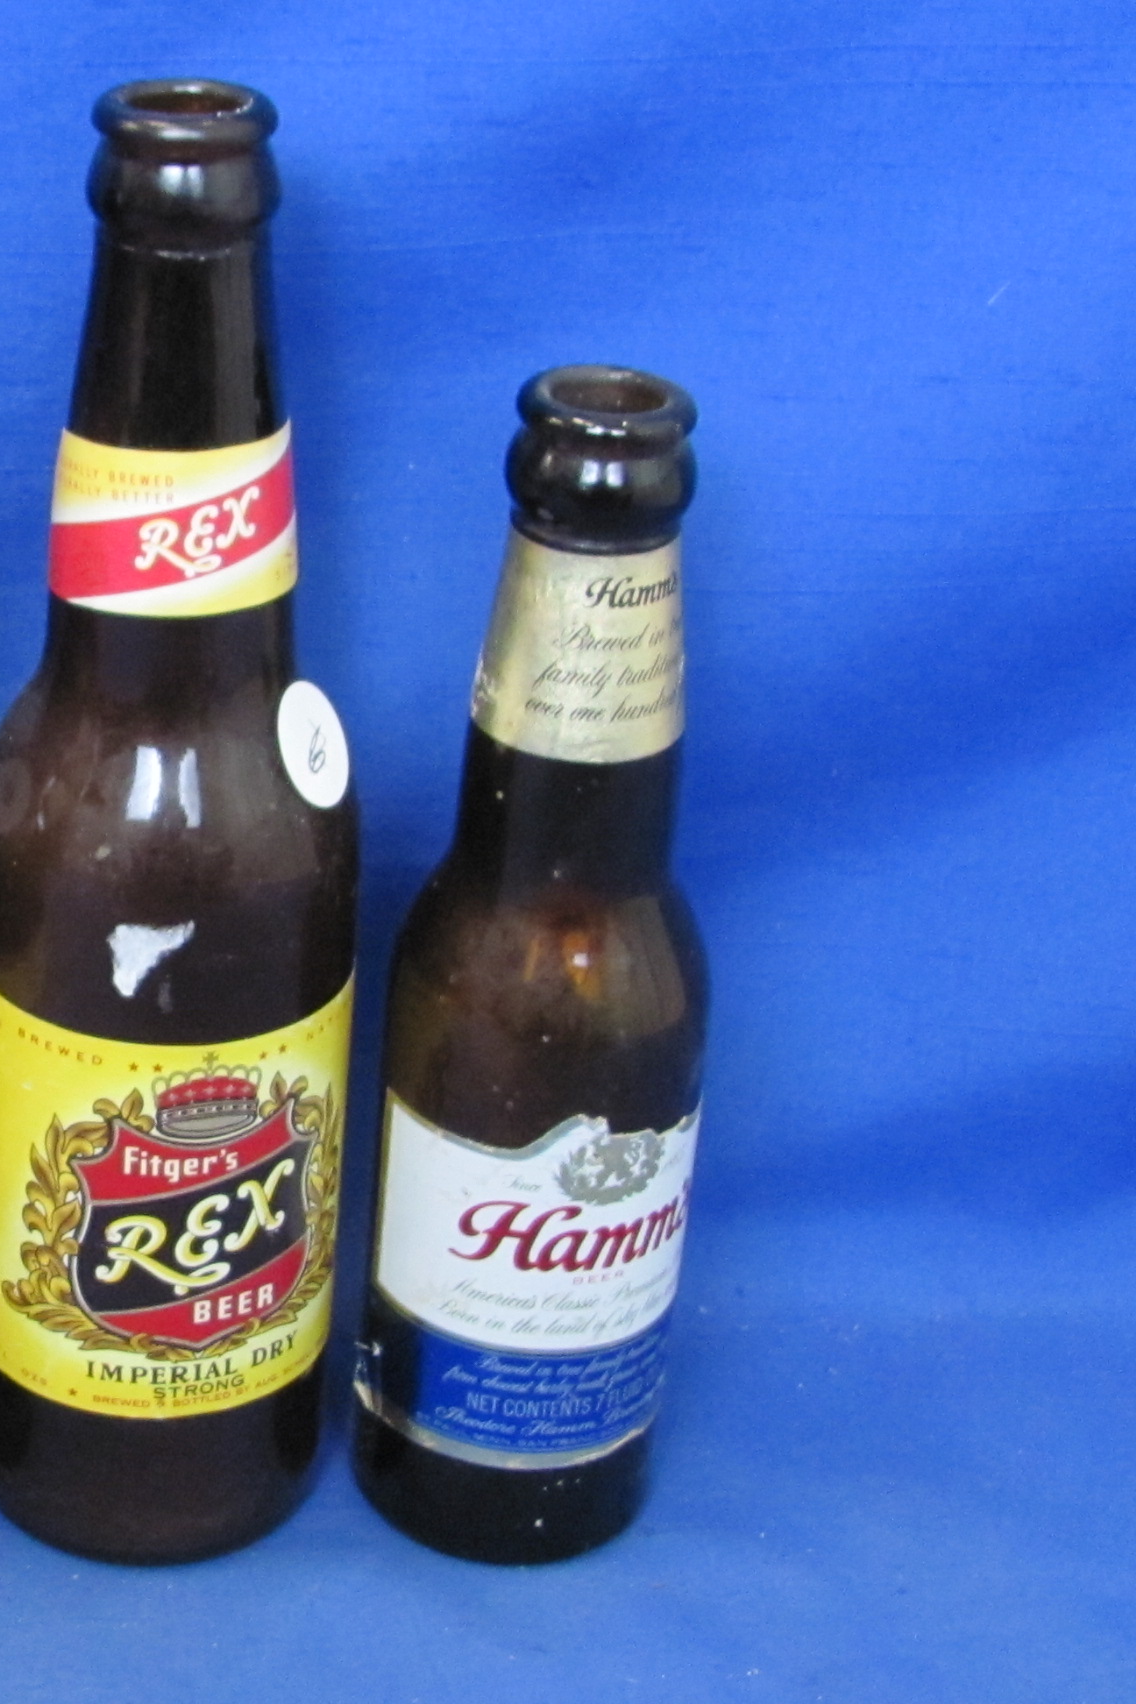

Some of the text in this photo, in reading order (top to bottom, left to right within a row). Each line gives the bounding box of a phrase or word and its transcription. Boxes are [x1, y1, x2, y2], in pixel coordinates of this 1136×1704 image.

[108, 469, 174, 488] BREWED
[111, 488, 175, 505] BETTER
[134, 485, 260, 579] REX
[552, 622, 651, 652] Brewed
[531, 659, 611, 698] family
[524, 698, 562, 720] over
[568, 708, 608, 723] one
[17, 1026, 103, 1066] BREWED
[123, 1145, 240, 1184] Fitger's
[94, 1157, 296, 1297] REX
[192, 1283, 275, 1325] BEER
[510, 1314, 543, 1335] the
[543, 1312, 598, 1336] land
[85, 1357, 239, 1386] IMPERIAL
[250, 1328, 300, 1368] DRY
[92, 1393, 150, 1409] BREWED
[173, 1390, 230, 1408] BOTTLED
[153, 1373, 246, 1400] STRONG
[466, 1390, 502, 1414] NET
[502, 1396, 593, 1419] CONTENTS
